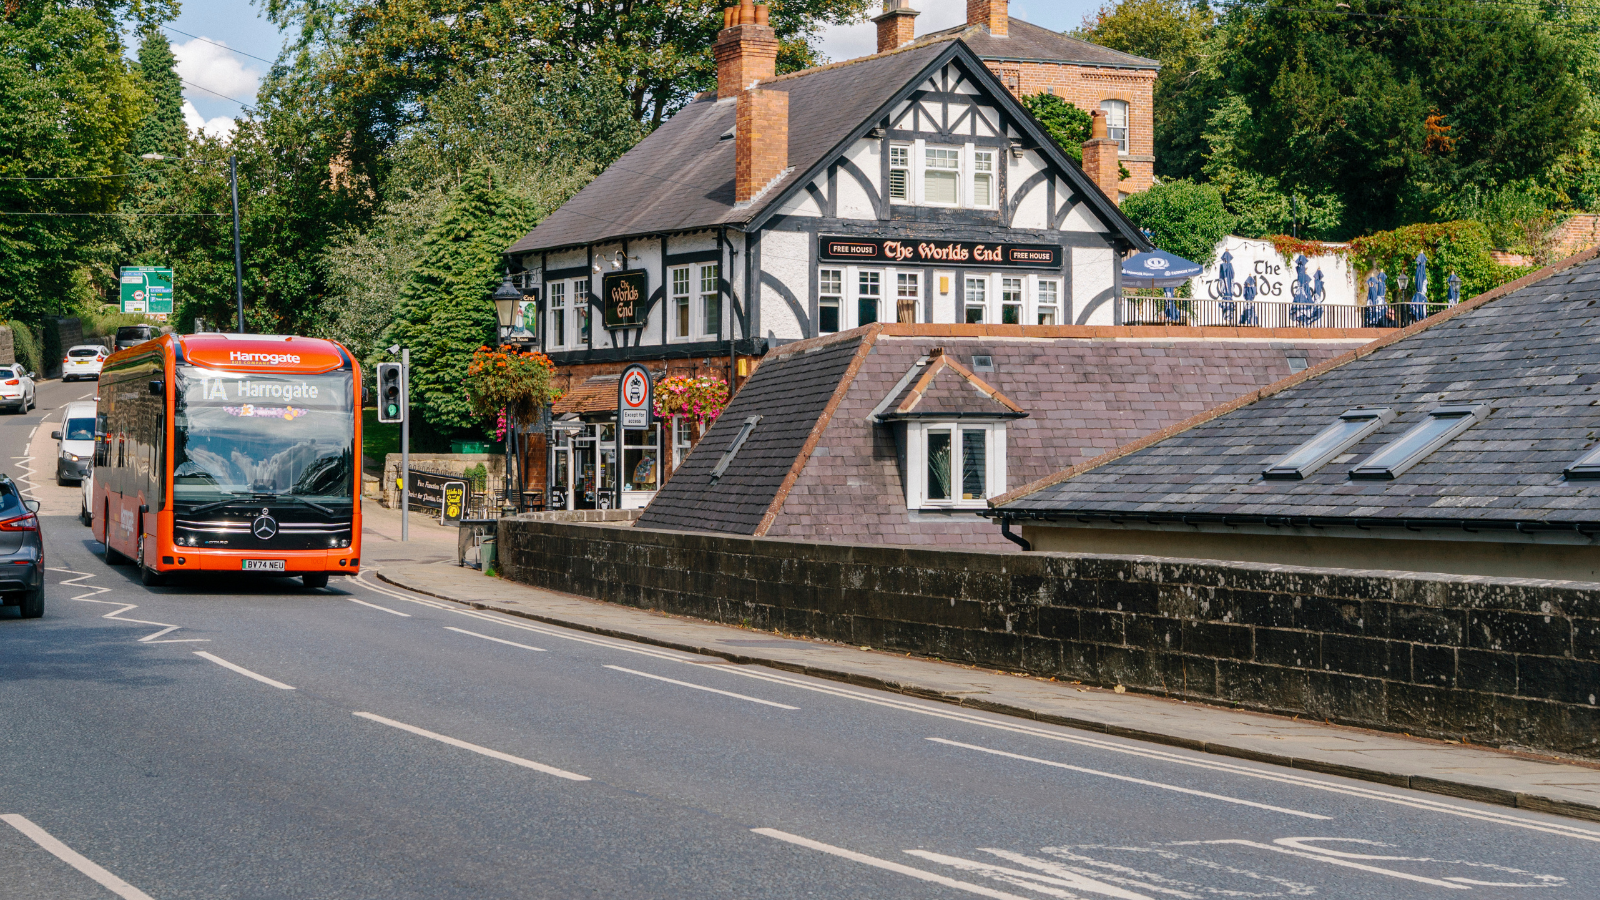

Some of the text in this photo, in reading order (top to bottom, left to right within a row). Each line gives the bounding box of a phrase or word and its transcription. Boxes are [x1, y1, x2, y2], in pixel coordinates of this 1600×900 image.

[833, 245, 873, 254] FREE HOUSE
[883, 240, 1003, 261] The Worlds End
[1014, 251, 1050, 260] FREE HOUSE
[1253, 260, 1281, 276] The
[620, 280, 630, 290] The
[1206, 275, 1283, 300] Wolds
[611, 285, 639, 302] Worlds
[617, 301, 633, 318] End
[229, 351, 301, 365] Harrogate
[200, 378, 319, 402] 1A Harrogate
[247, 560, 284, 569] BV74 NEU
